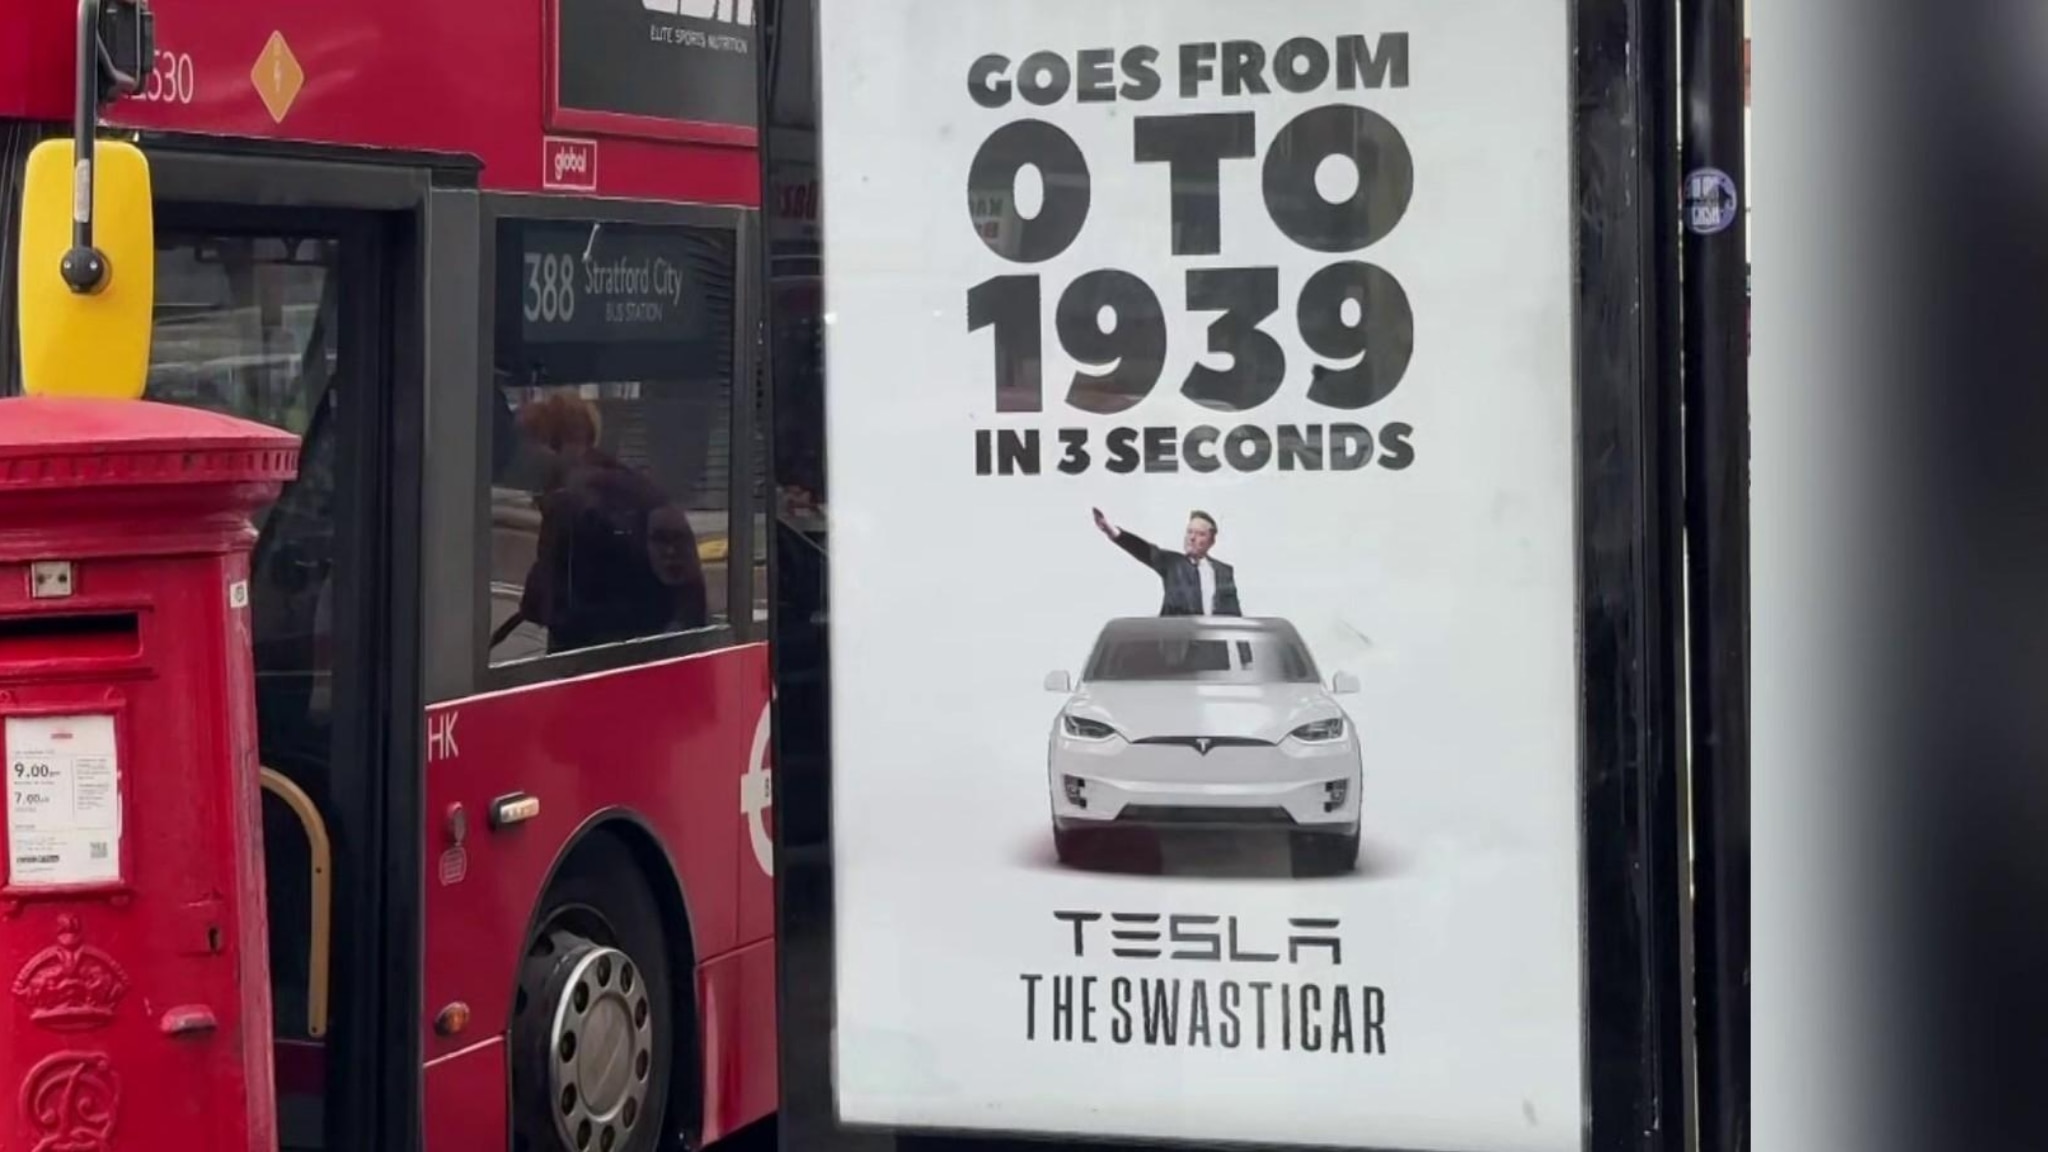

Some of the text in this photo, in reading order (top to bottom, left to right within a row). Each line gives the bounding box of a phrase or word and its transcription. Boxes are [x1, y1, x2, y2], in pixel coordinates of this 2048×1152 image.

[650, 24, 748, 54] ELITE SPORTS NUTRITION
[131, 50, 194, 104] 530
[967, 32, 1409, 108] GOES FROM
[554, 147, 586, 180] global
[967, 103, 1414, 263] 0 TO
[523, 252, 682, 323] 388 Stratford City
[606, 303, 663, 323] BUS STATION
[967, 260, 1414, 415] 1939
[975, 422, 1415, 476] IN 3 SECONDS
[427, 711, 459, 762] HK
[1053, 910, 1341, 965] TESLA
[1020, 973, 1386, 1055] THE SWASTICAR
